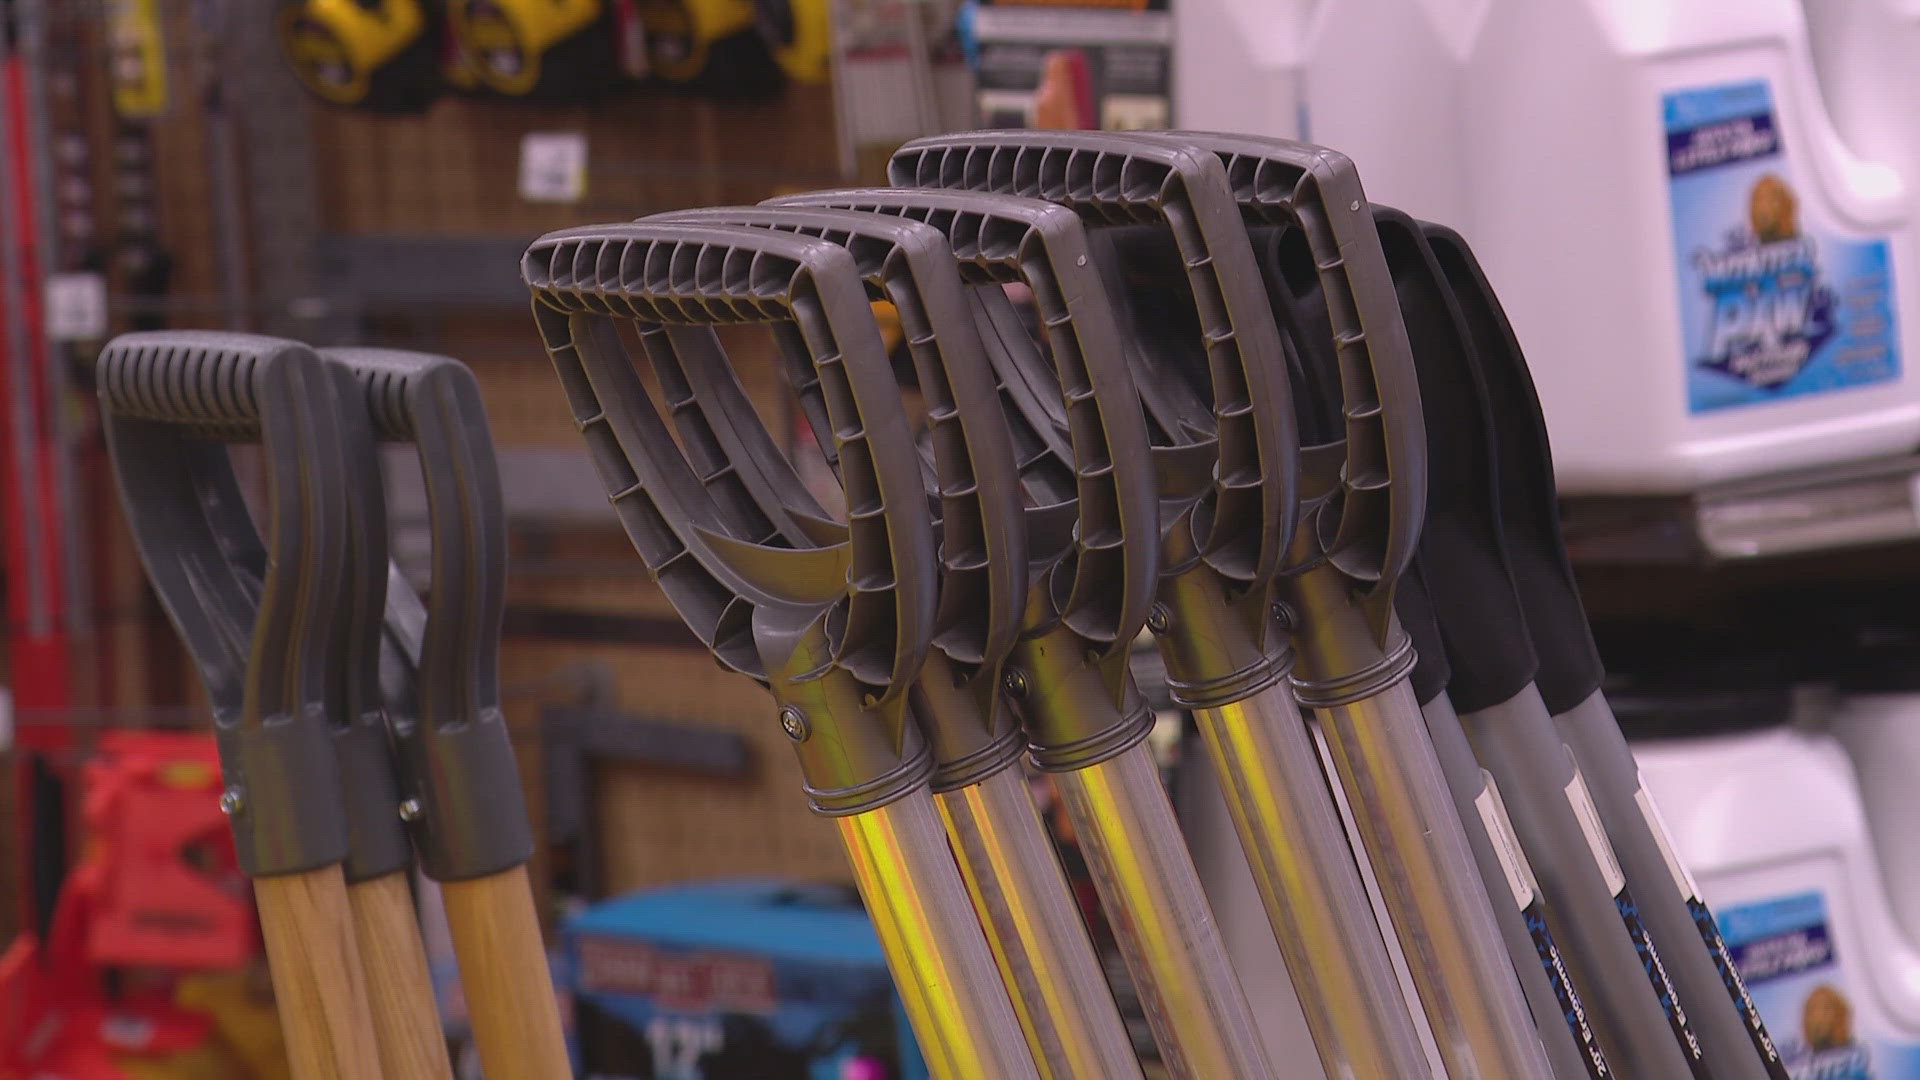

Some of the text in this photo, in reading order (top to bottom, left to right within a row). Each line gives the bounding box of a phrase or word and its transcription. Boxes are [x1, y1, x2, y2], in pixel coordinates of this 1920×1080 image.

[1549, 945, 1593, 1044] Ergonomic
[1643, 930, 1687, 1028] Ergonomic
[1715, 935, 1762, 1031] Ergonomic
